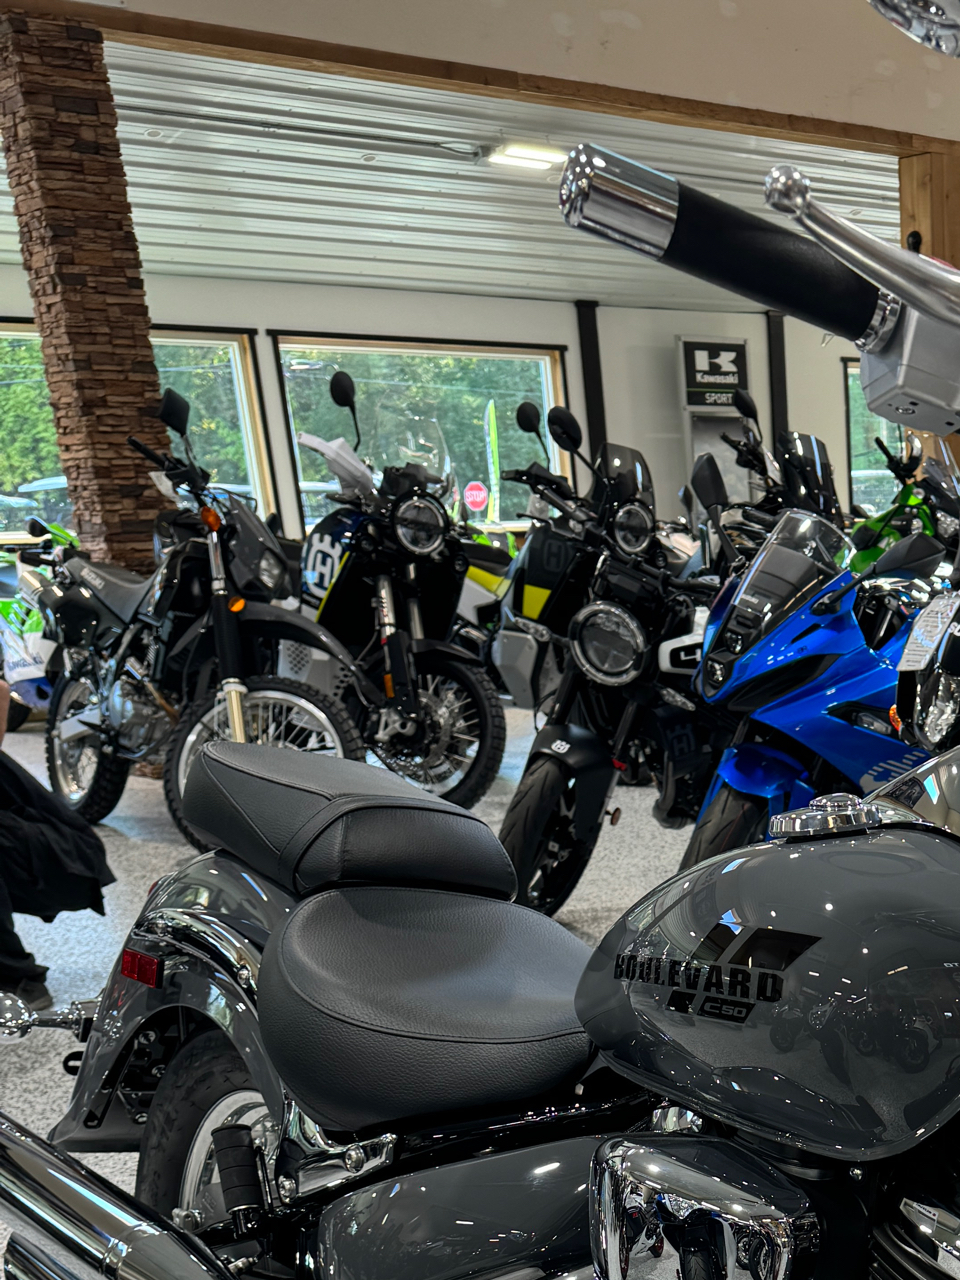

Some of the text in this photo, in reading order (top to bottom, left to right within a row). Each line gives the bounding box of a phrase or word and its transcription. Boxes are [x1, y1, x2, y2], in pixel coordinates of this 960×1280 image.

[695, 372, 739, 385] Kawasaki
[704, 392, 734, 405] SPORT
[465, 490, 486, 502] STOP
[613, 953, 785, 1003] BOULEVARD
